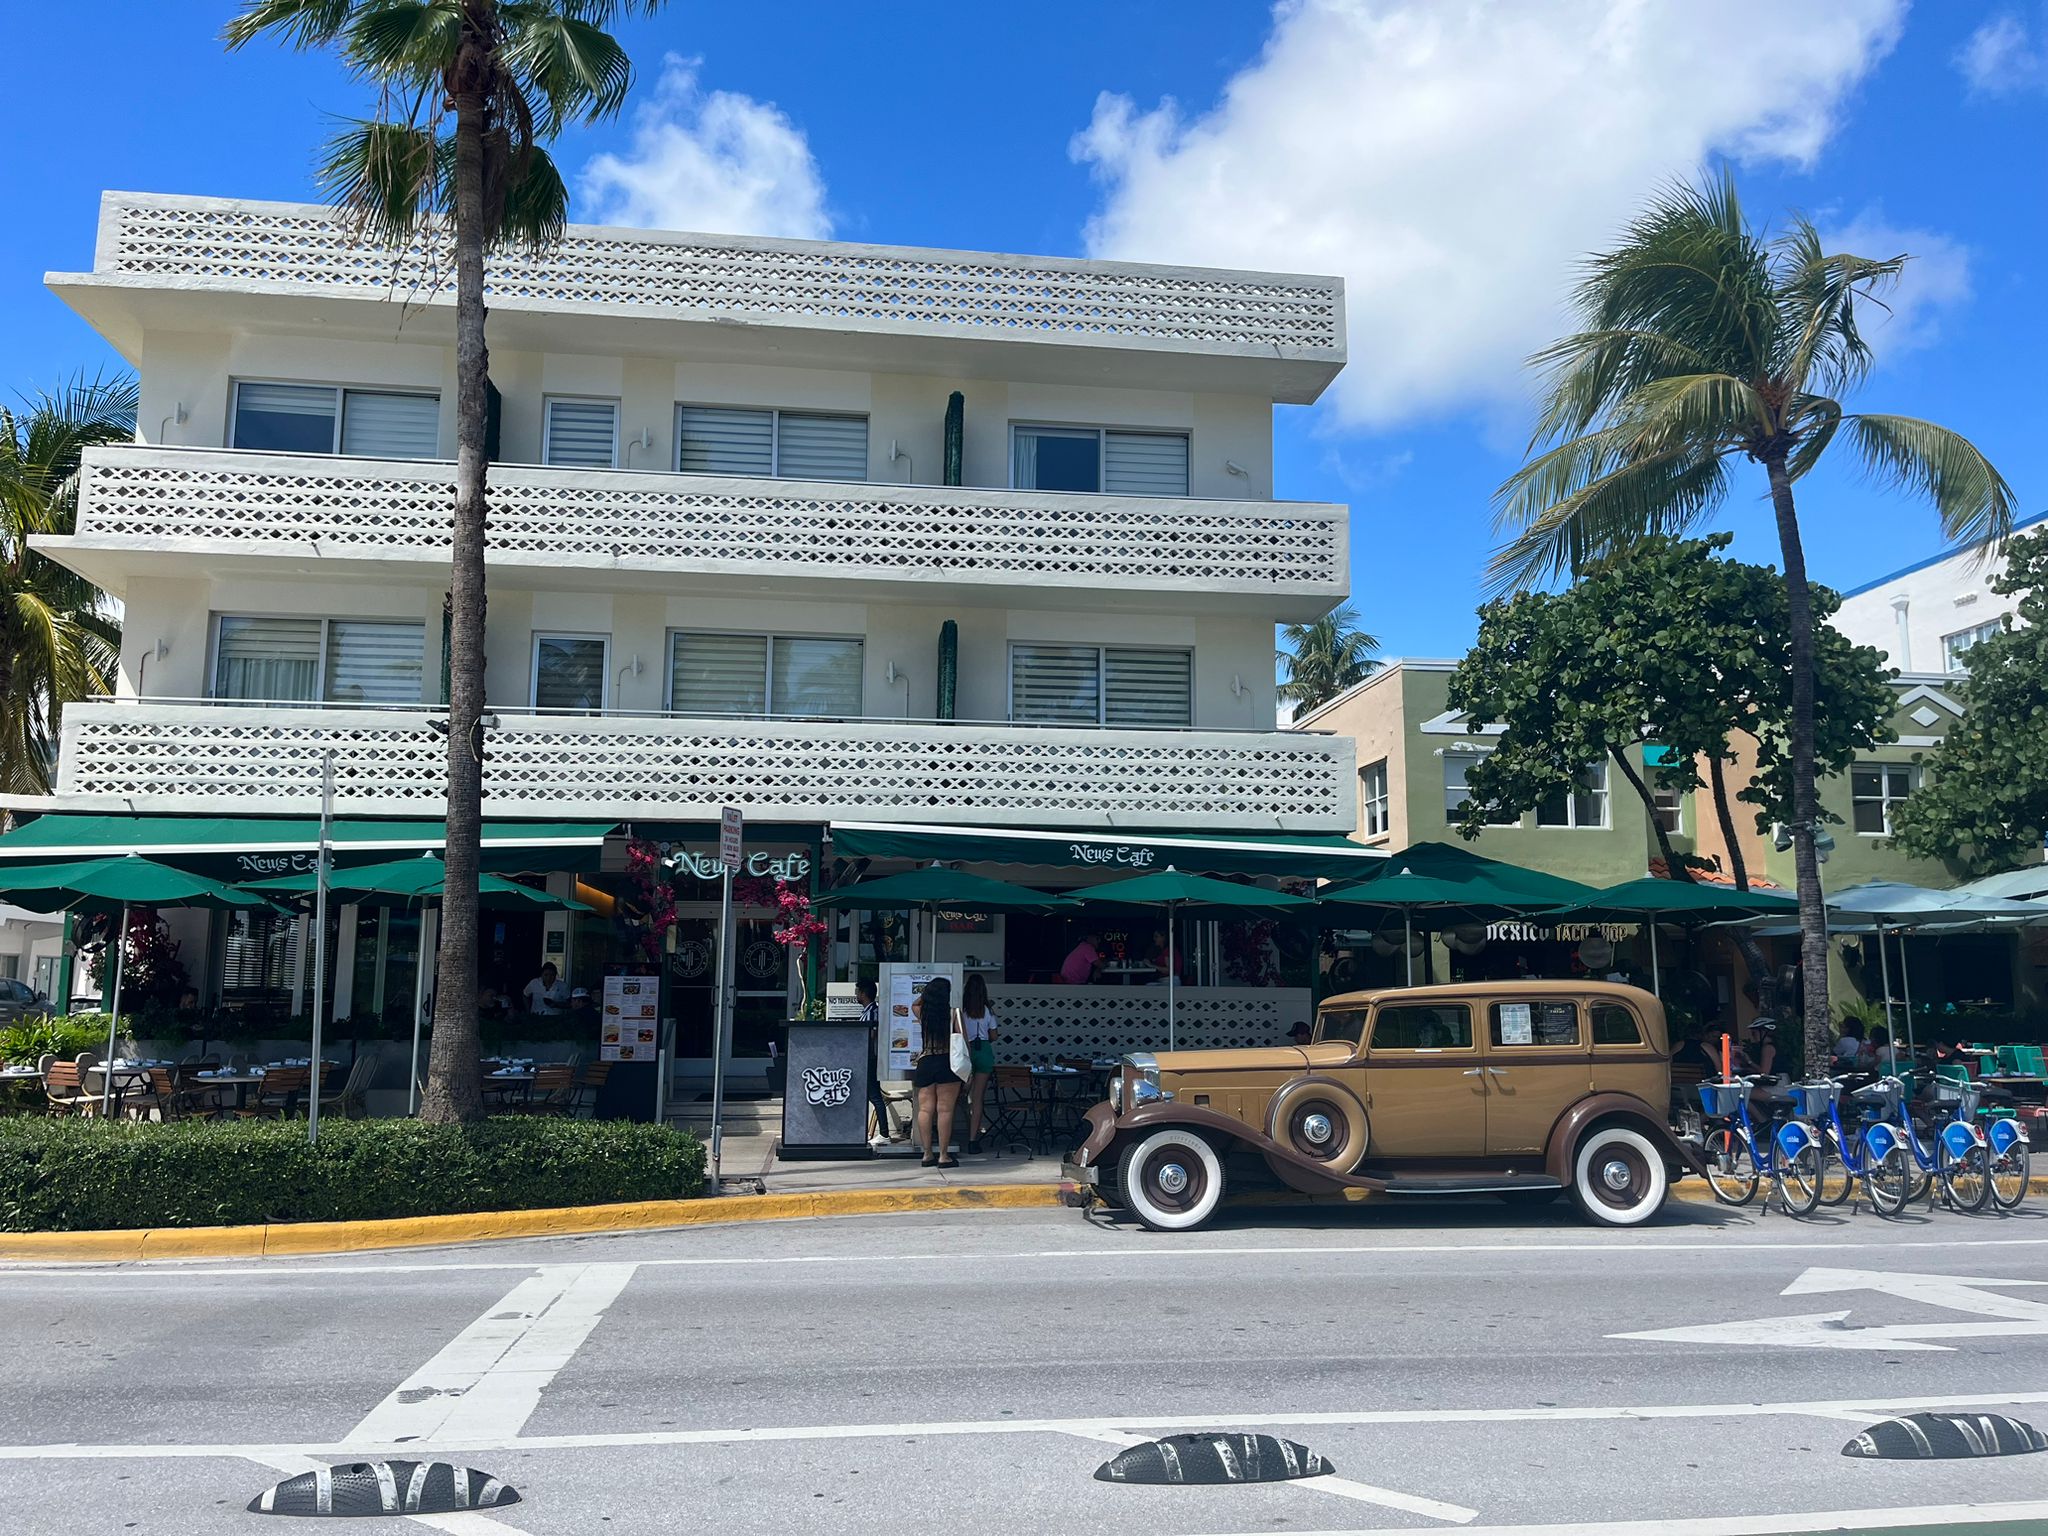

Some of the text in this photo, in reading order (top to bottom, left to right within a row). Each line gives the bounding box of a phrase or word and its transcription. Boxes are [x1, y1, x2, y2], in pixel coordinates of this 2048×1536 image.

[236, 854, 336, 873] News Ca
[1069, 844, 1155, 867] News Cafe
[747, 851, 811, 882] Cafe
[1592, 923, 1628, 942] HOP
[803, 1069, 851, 1087] News
[806, 1081, 850, 1105] Cafe
